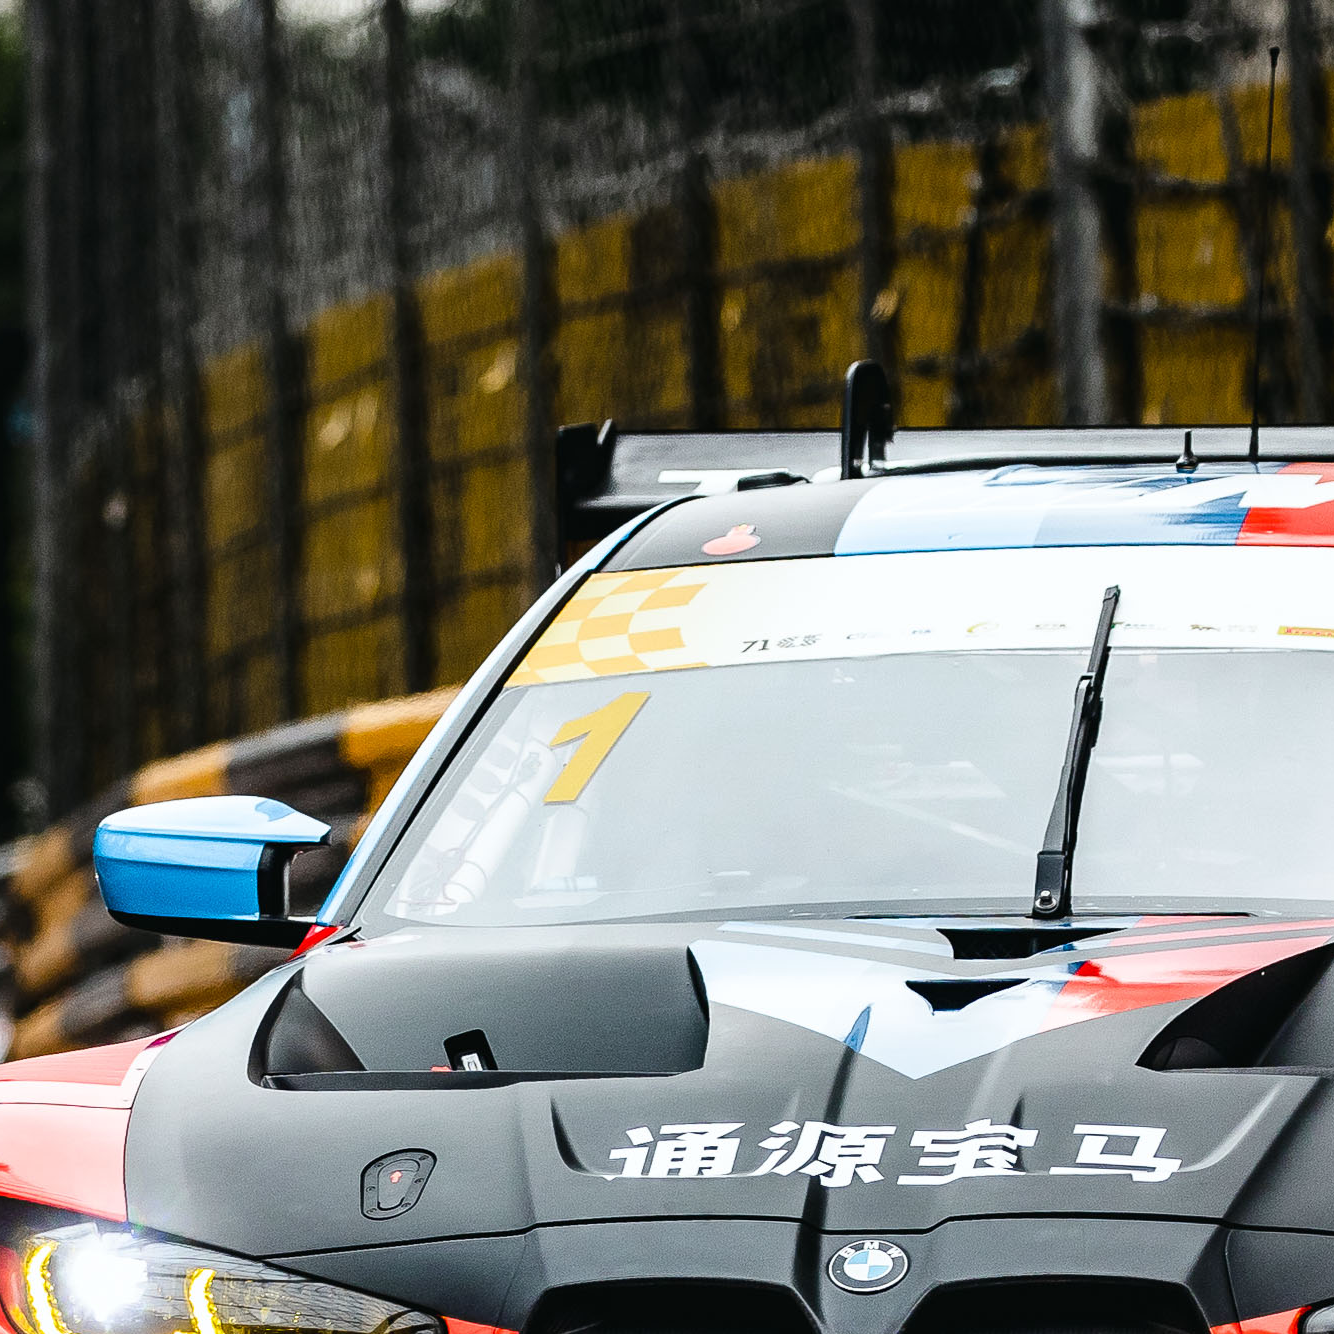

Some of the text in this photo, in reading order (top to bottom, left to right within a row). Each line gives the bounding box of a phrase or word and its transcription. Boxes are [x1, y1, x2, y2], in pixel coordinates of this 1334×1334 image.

[741, 639, 770, 654] 71
[543, 690, 652, 805] 1
[600, 1117, 1184, 1188] 通源宝马
